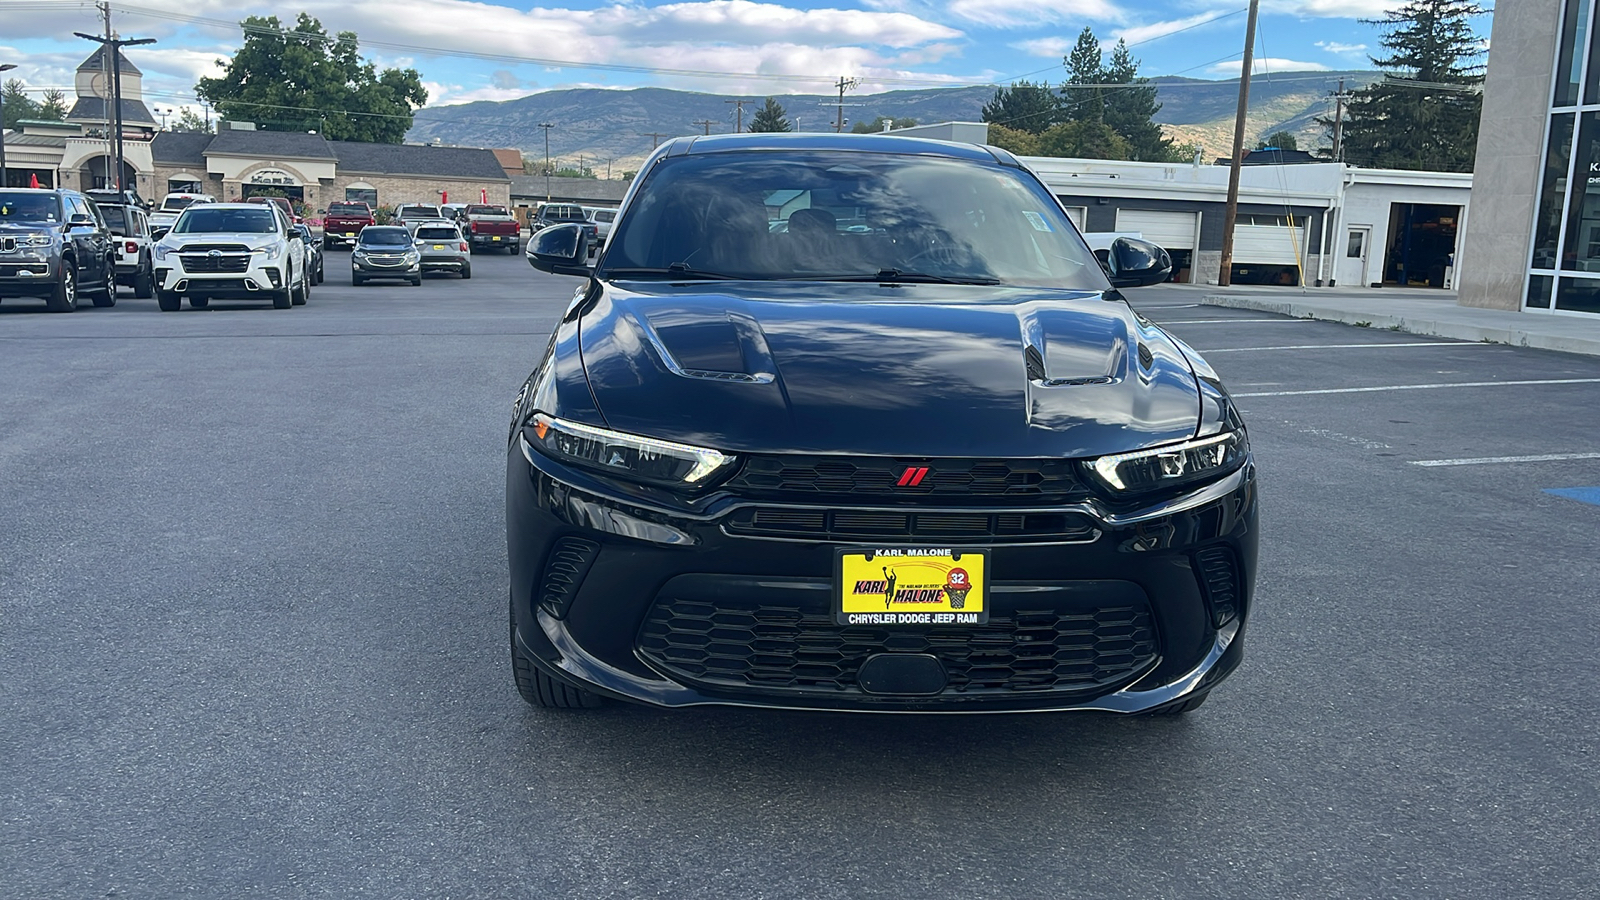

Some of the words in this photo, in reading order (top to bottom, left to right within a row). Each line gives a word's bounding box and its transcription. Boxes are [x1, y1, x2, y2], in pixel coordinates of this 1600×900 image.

[1590, 162, 1600, 171] K
[875, 549, 904, 557] KARL
[907, 549, 952, 557] MALONE
[951, 573, 965, 584] 32
[853, 580, 887, 595] KARL
[893, 589, 944, 603] MALONE
[848, 613, 897, 624] CHRYSLER
[898, 613, 931, 623] DODGE
[932, 613, 954, 623] JEEP
[957, 613, 978, 623] RAM
